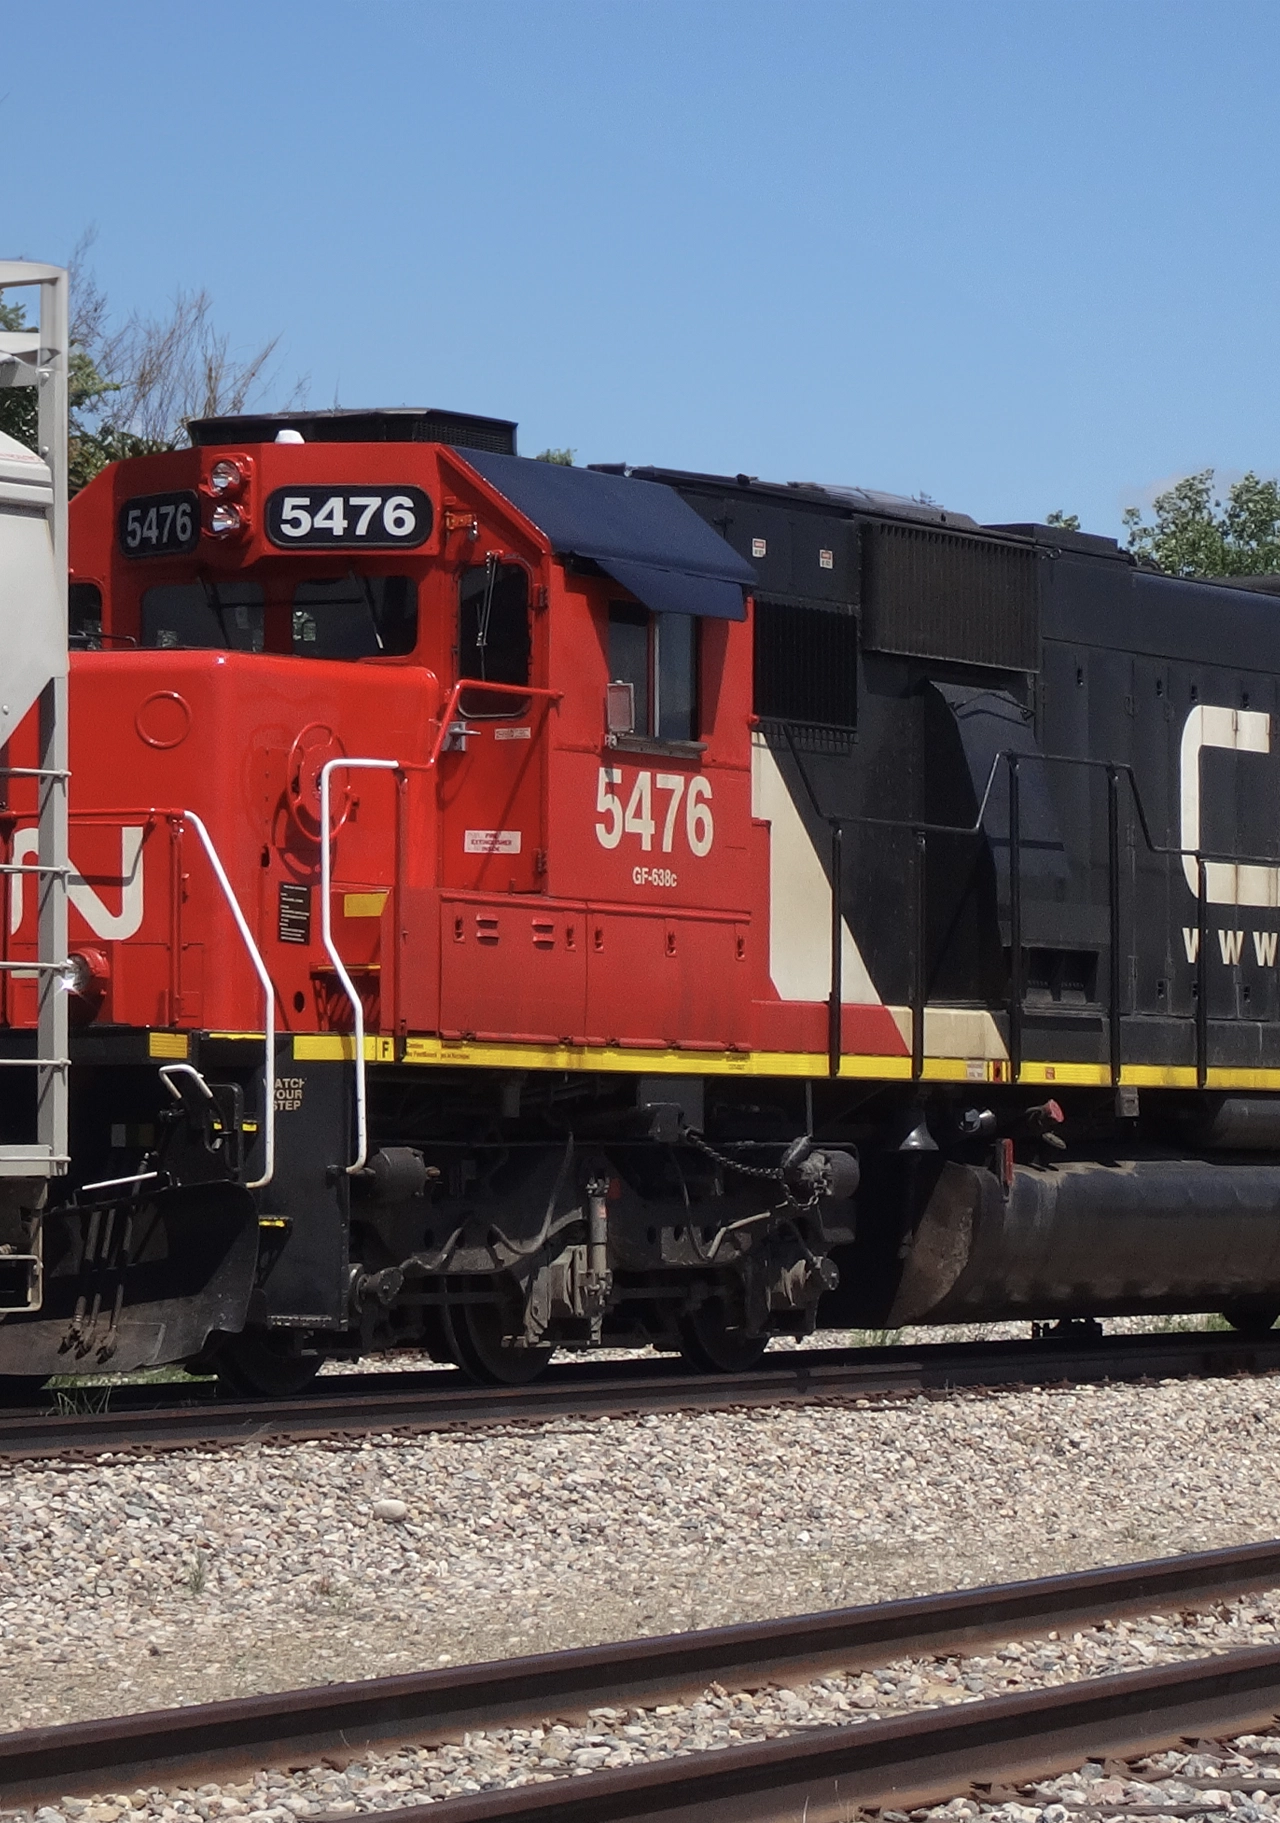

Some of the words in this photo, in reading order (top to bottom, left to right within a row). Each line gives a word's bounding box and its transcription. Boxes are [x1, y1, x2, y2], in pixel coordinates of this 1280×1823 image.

[126, 502, 193, 549] 5476
[280, 496, 416, 538] 5476
[595, 767, 714, 857] 5476
[12, 827, 144, 941] N
[632, 867, 678, 888] GF-638c
[382, 1041, 390, 1059] F
[273, 1089, 303, 1100] OUR
